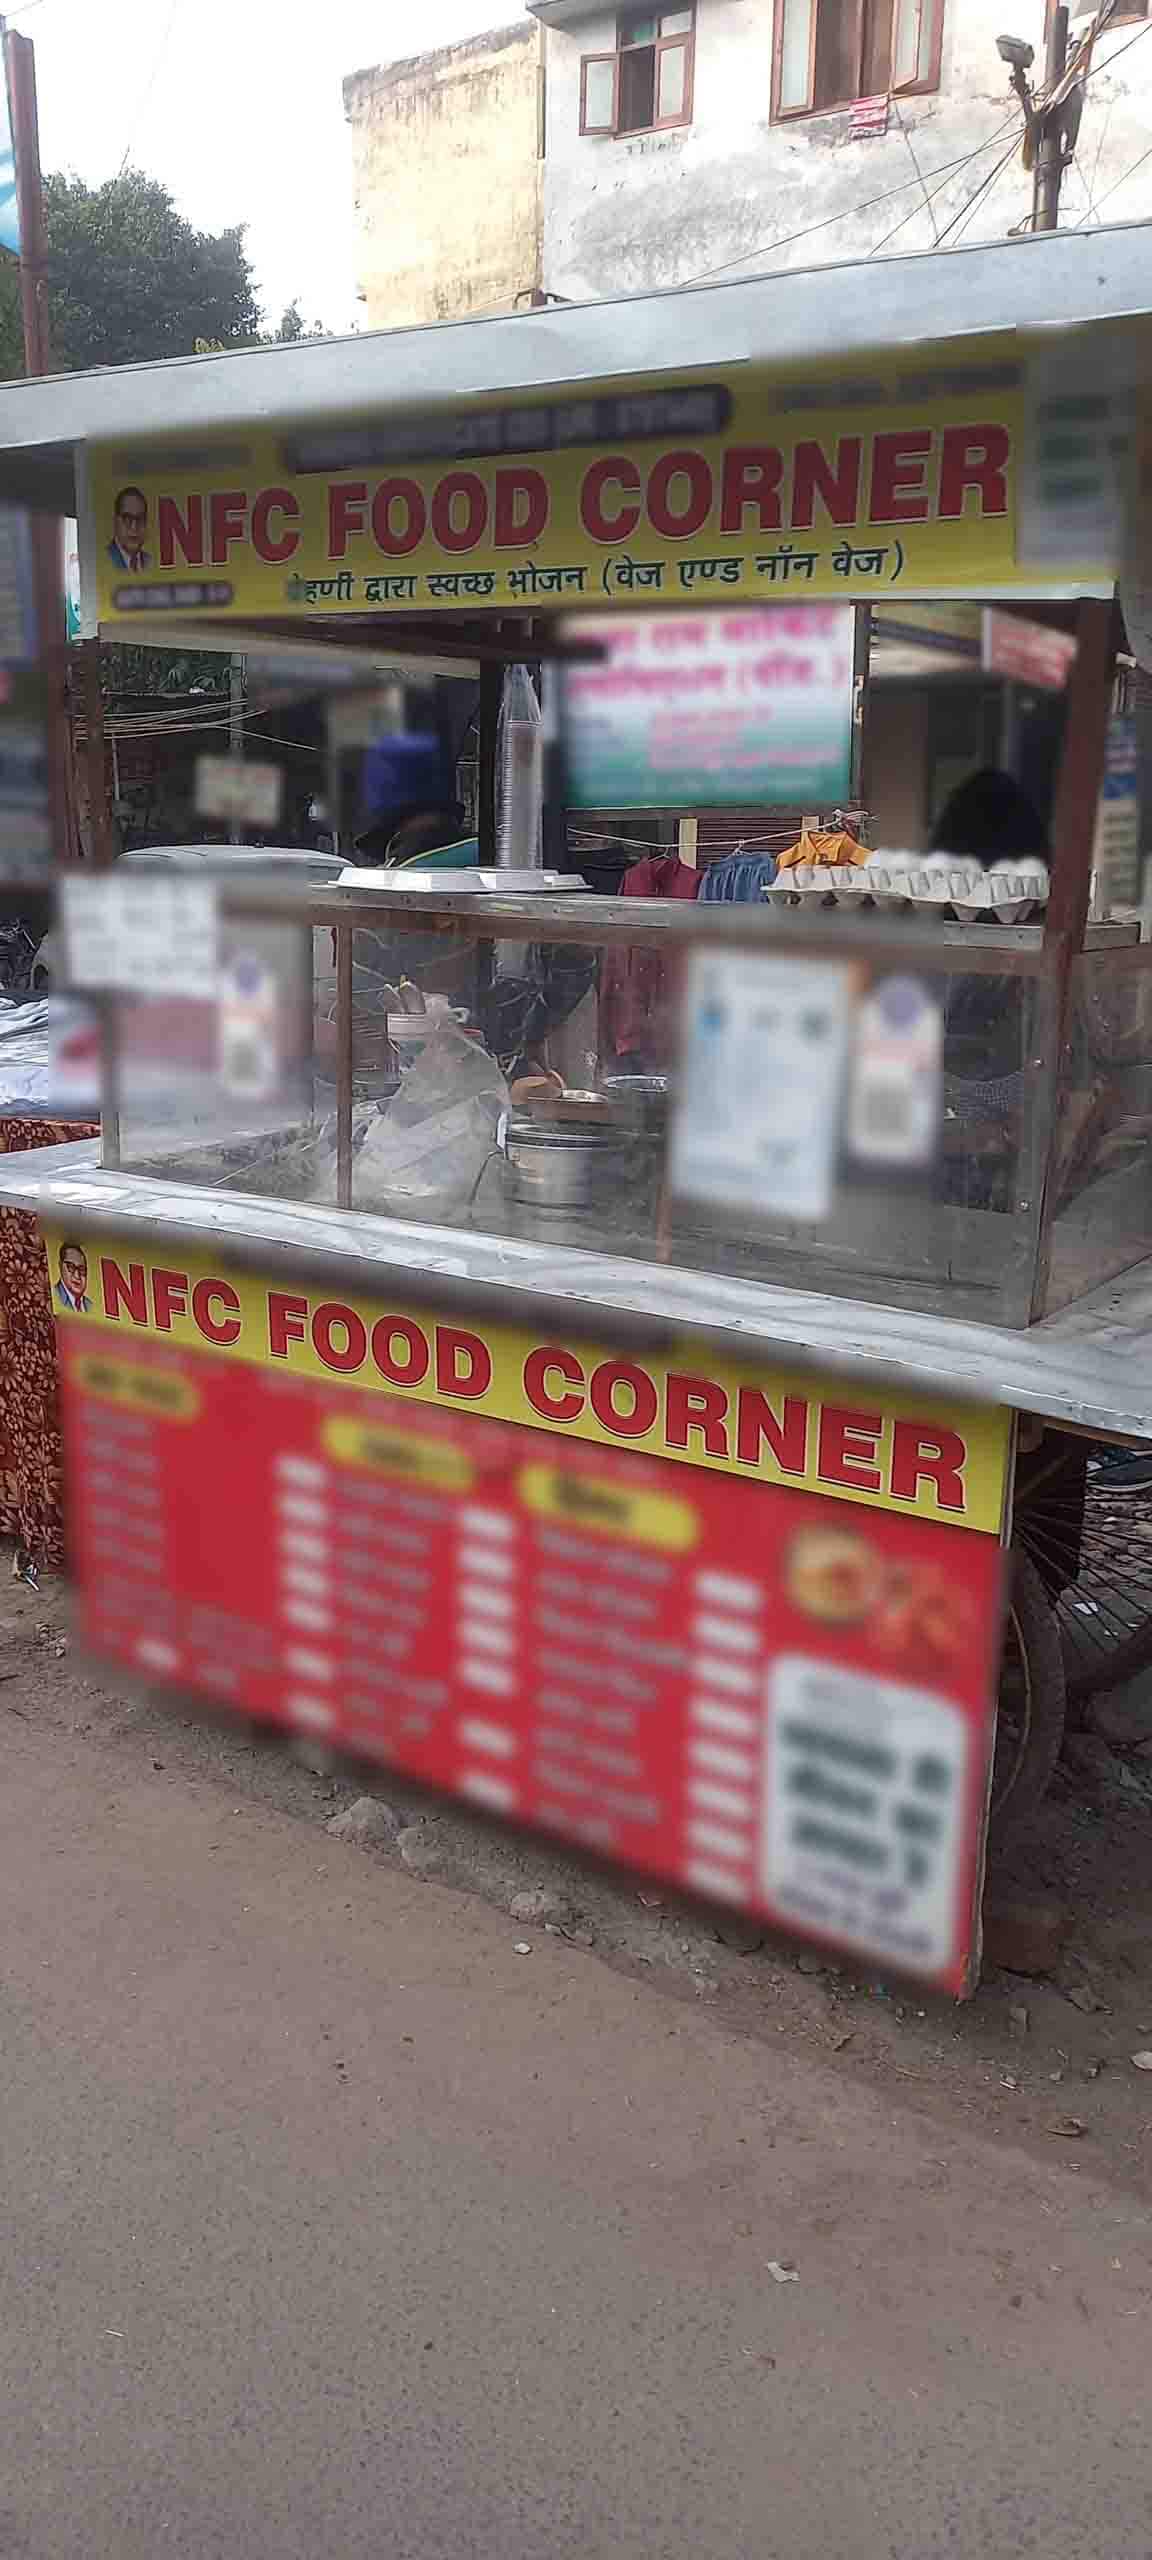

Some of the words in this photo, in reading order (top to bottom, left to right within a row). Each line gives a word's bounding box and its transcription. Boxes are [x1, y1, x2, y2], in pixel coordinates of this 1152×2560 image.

[158, 487, 301, 569] NFC
[326, 466, 551, 561] FOOD
[579, 422, 1010, 546] CORNER
[363, 575, 418, 603] द्वारा
[426, 570, 496, 598] स्वच्छ
[507, 560, 589, 597] भोजन
[602, 554, 665, 596] (वेज
[677, 556, 745, 588] एण्ड
[755, 544, 820, 582] नॉन
[97, 1256, 243, 1346] NFC
[266, 1290, 493, 1400] FOOD
[521, 1344, 967, 1514] CORNER
